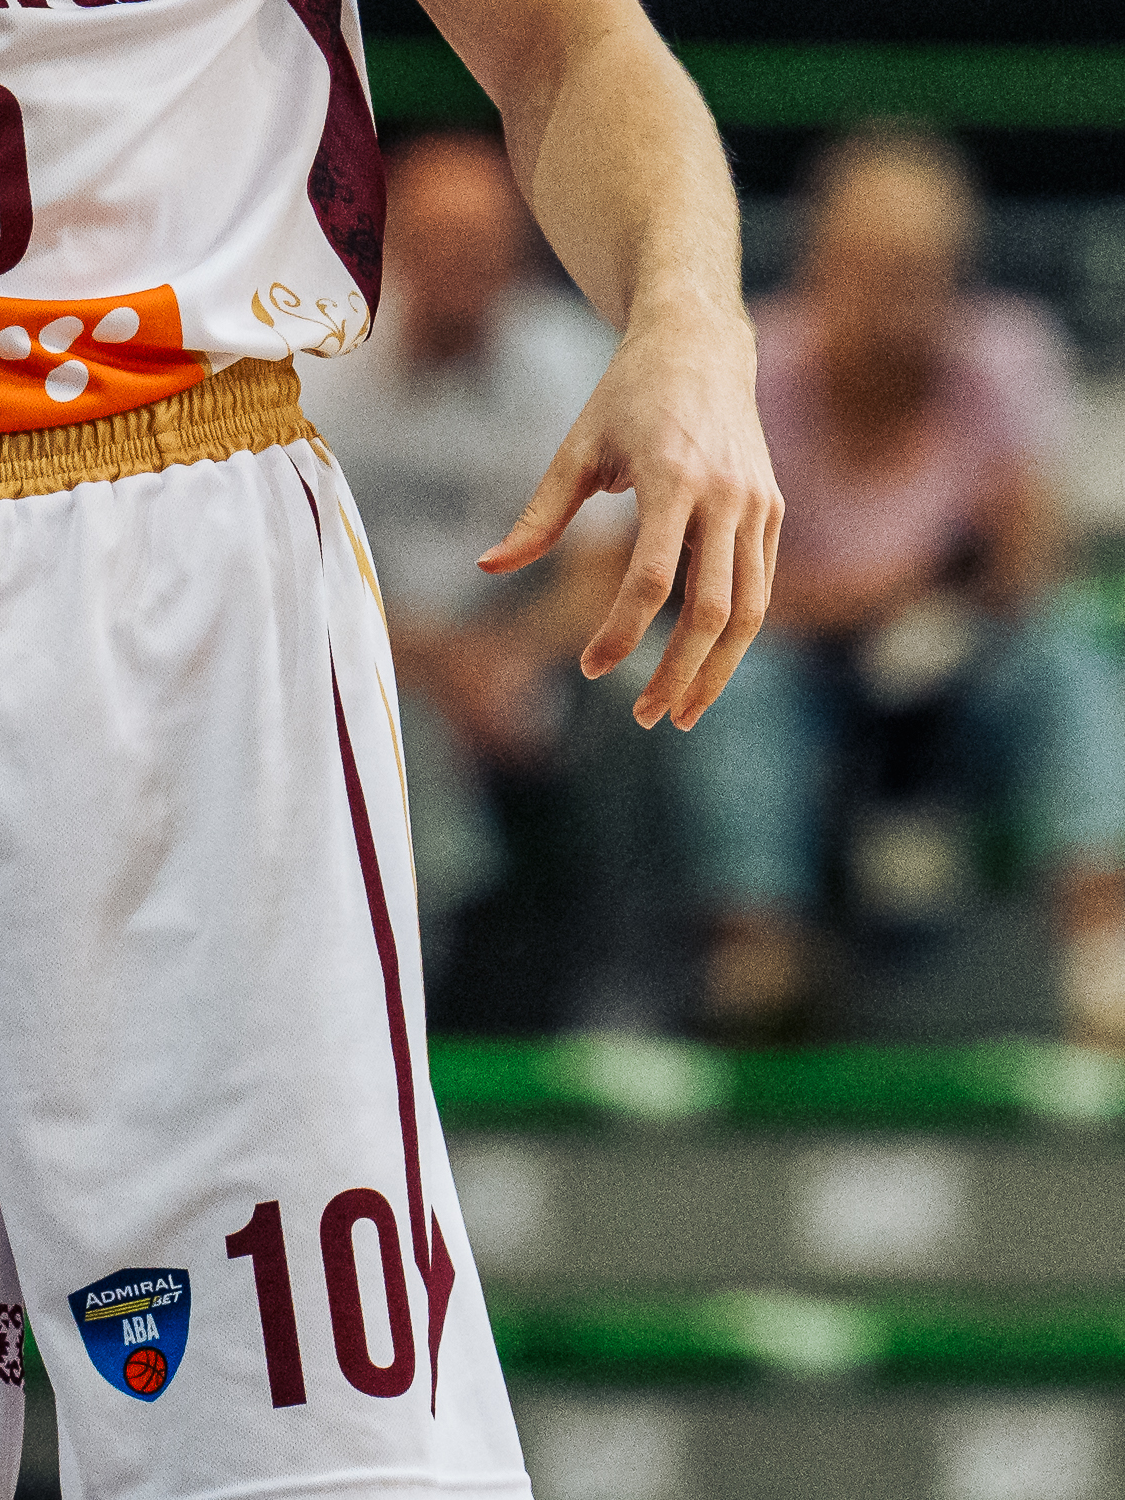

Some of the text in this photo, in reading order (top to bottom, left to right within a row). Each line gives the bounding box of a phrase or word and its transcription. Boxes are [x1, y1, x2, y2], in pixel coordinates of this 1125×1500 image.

[85, 1273, 183, 1310] ADMIRAL
[151, 1290, 183, 1308] BET
[225, 1187, 417, 1410] 10
[121, 1312, 161, 1347] ABA
